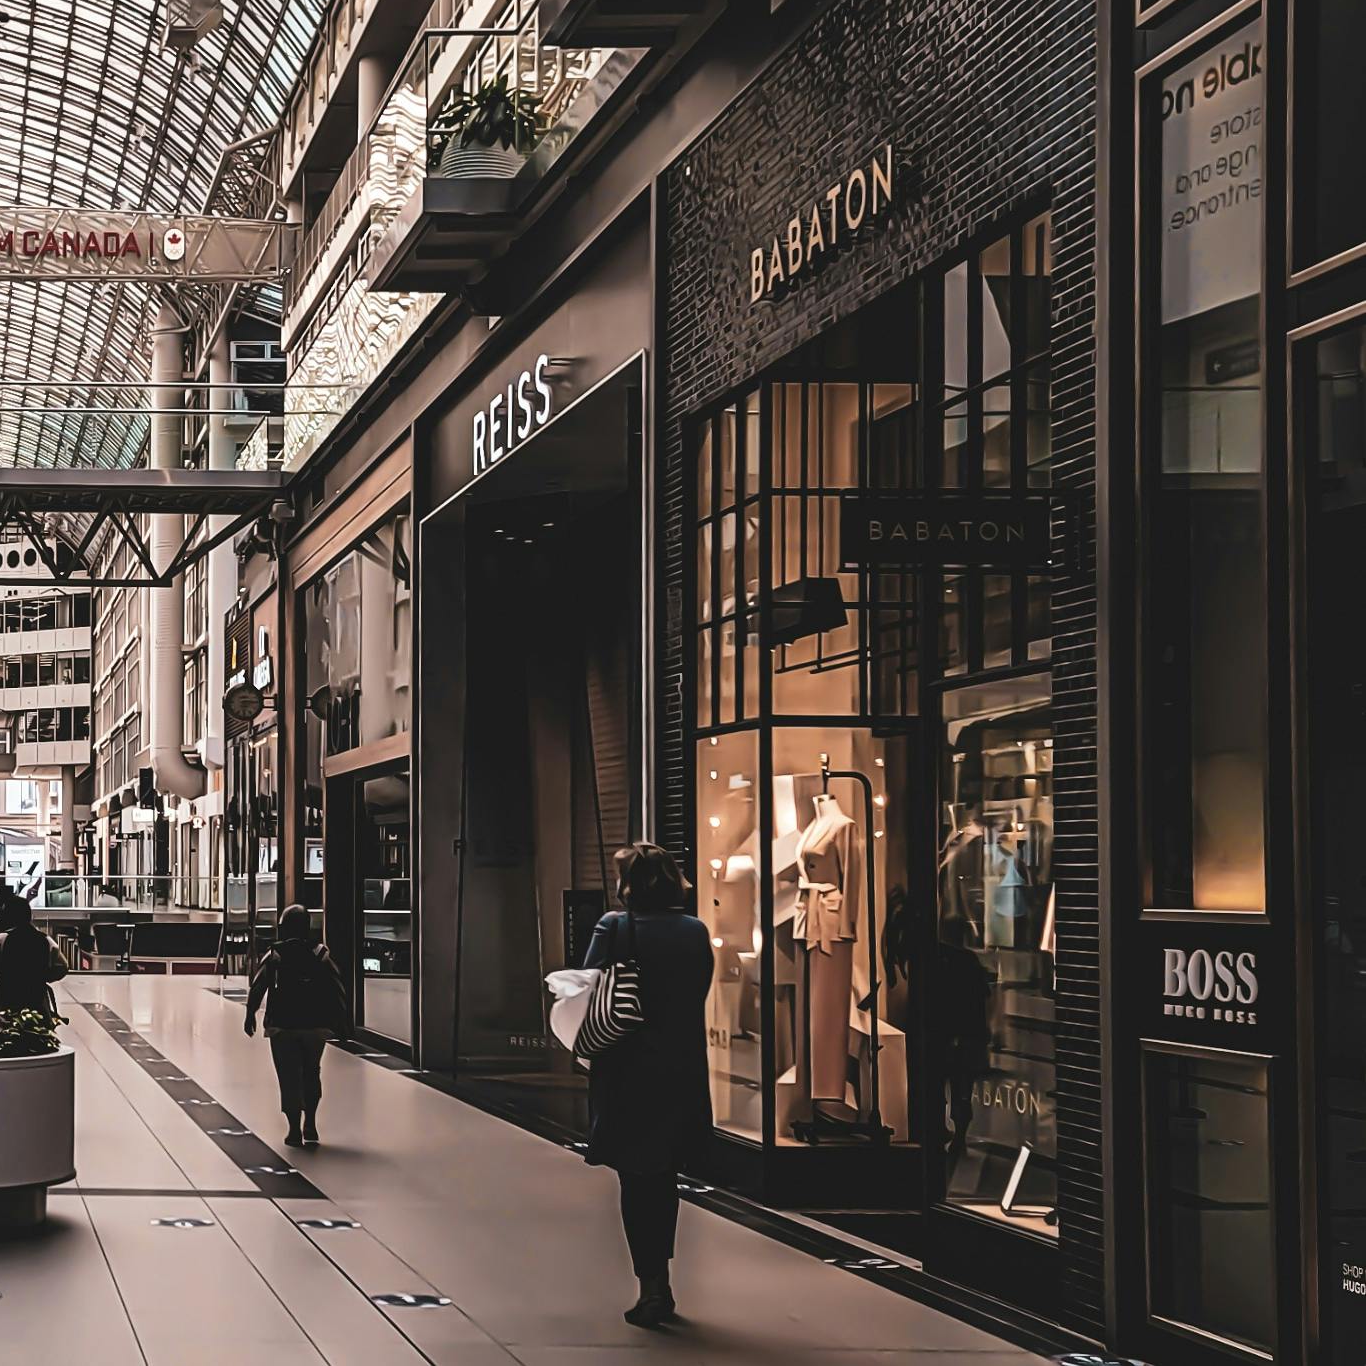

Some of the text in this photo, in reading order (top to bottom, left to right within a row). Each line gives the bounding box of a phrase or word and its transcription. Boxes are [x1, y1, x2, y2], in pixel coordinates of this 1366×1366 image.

[22, 231, 142, 258] CANADA
[750, 144, 892, 304] BABATON
[474, 354, 550, 476] REISS
[869, 520, 1024, 542] BABATON
[1163, 948, 1259, 1004] BOSS
[971, 1082, 1040, 1116] ABATON
